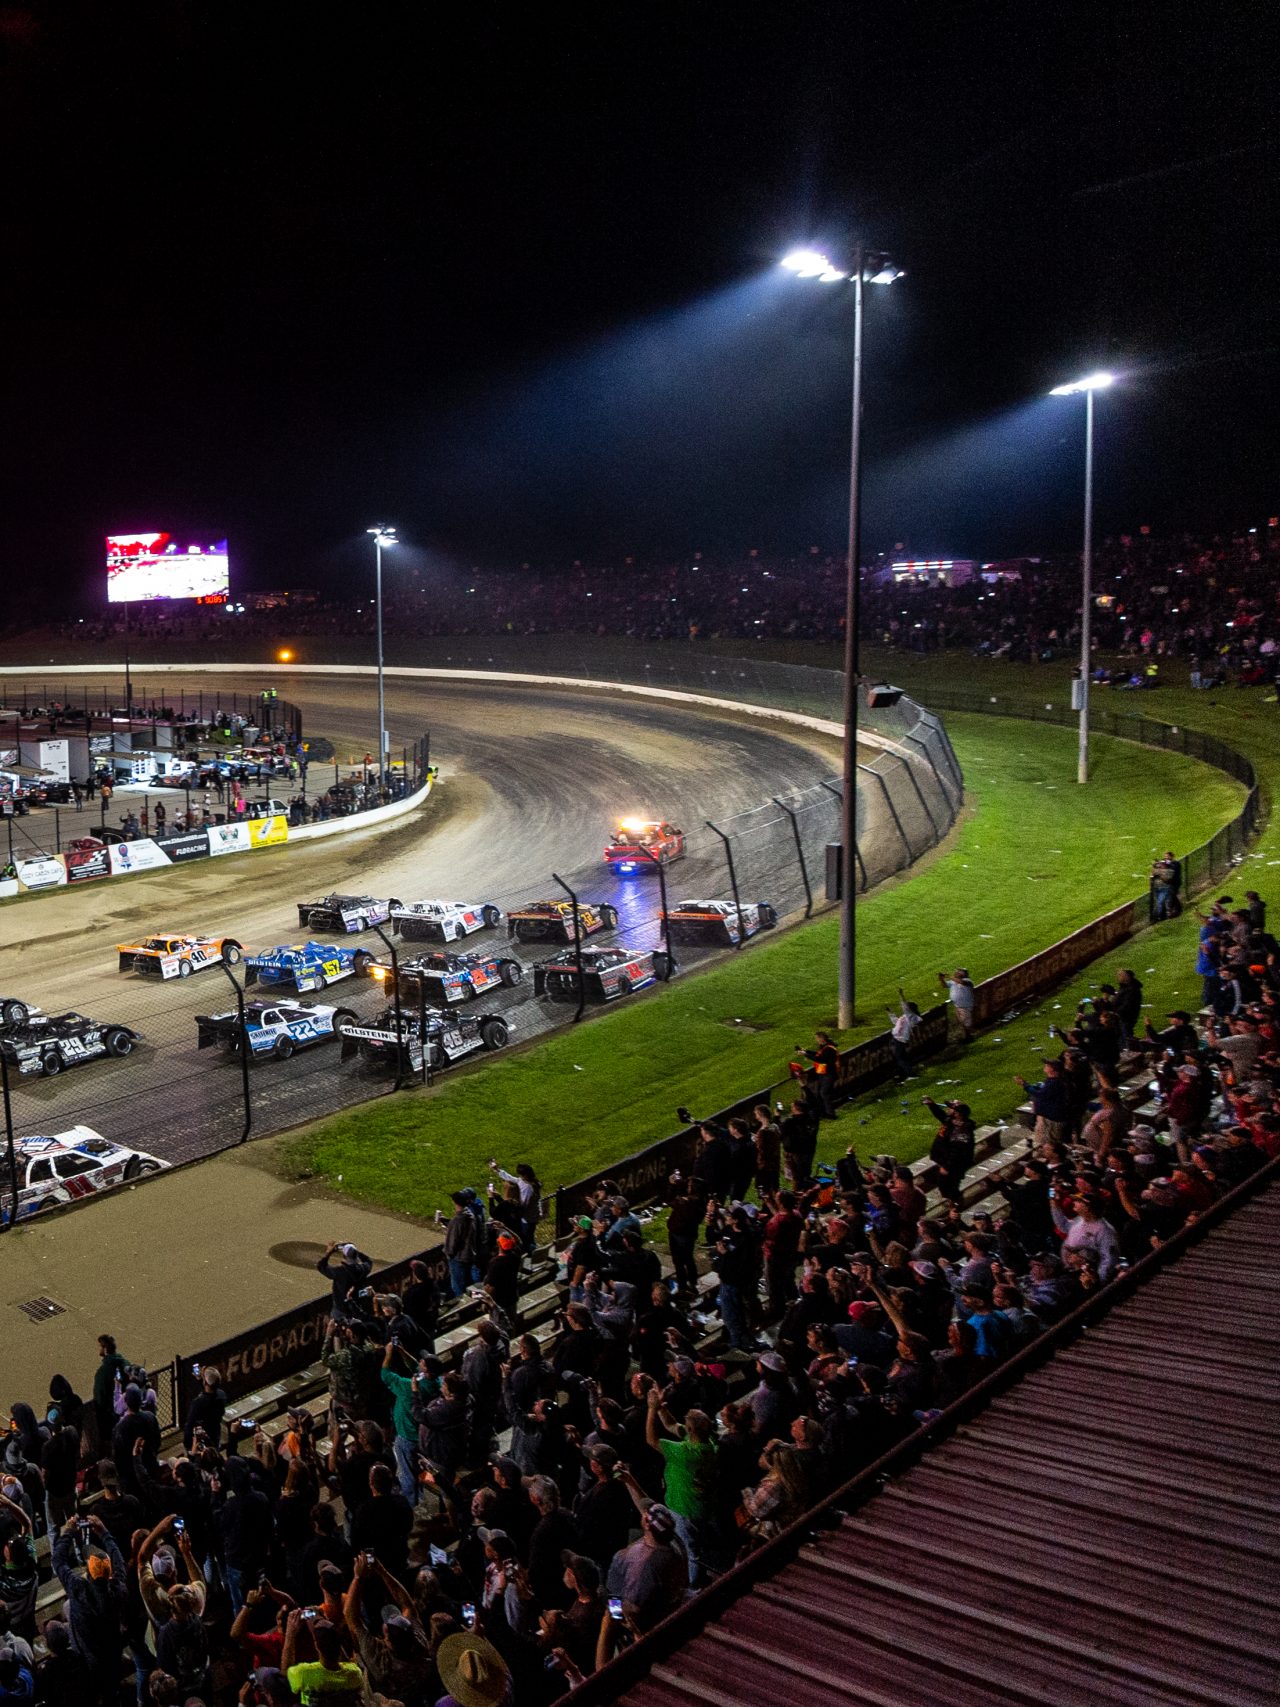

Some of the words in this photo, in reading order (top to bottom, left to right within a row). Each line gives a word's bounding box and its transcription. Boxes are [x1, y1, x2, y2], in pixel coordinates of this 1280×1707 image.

[176, 844, 207, 856] FLORACING
[248, 960, 281, 968] BILSTEIN
[322, 959, 341, 977] 157
[290, 1020, 316, 1042] 22
[344, 1027, 389, 1040] BILSTEIN
[443, 1030, 464, 1050] 46
[59, 1037, 86, 1057] 29
[61, 1174, 98, 1200] 11
